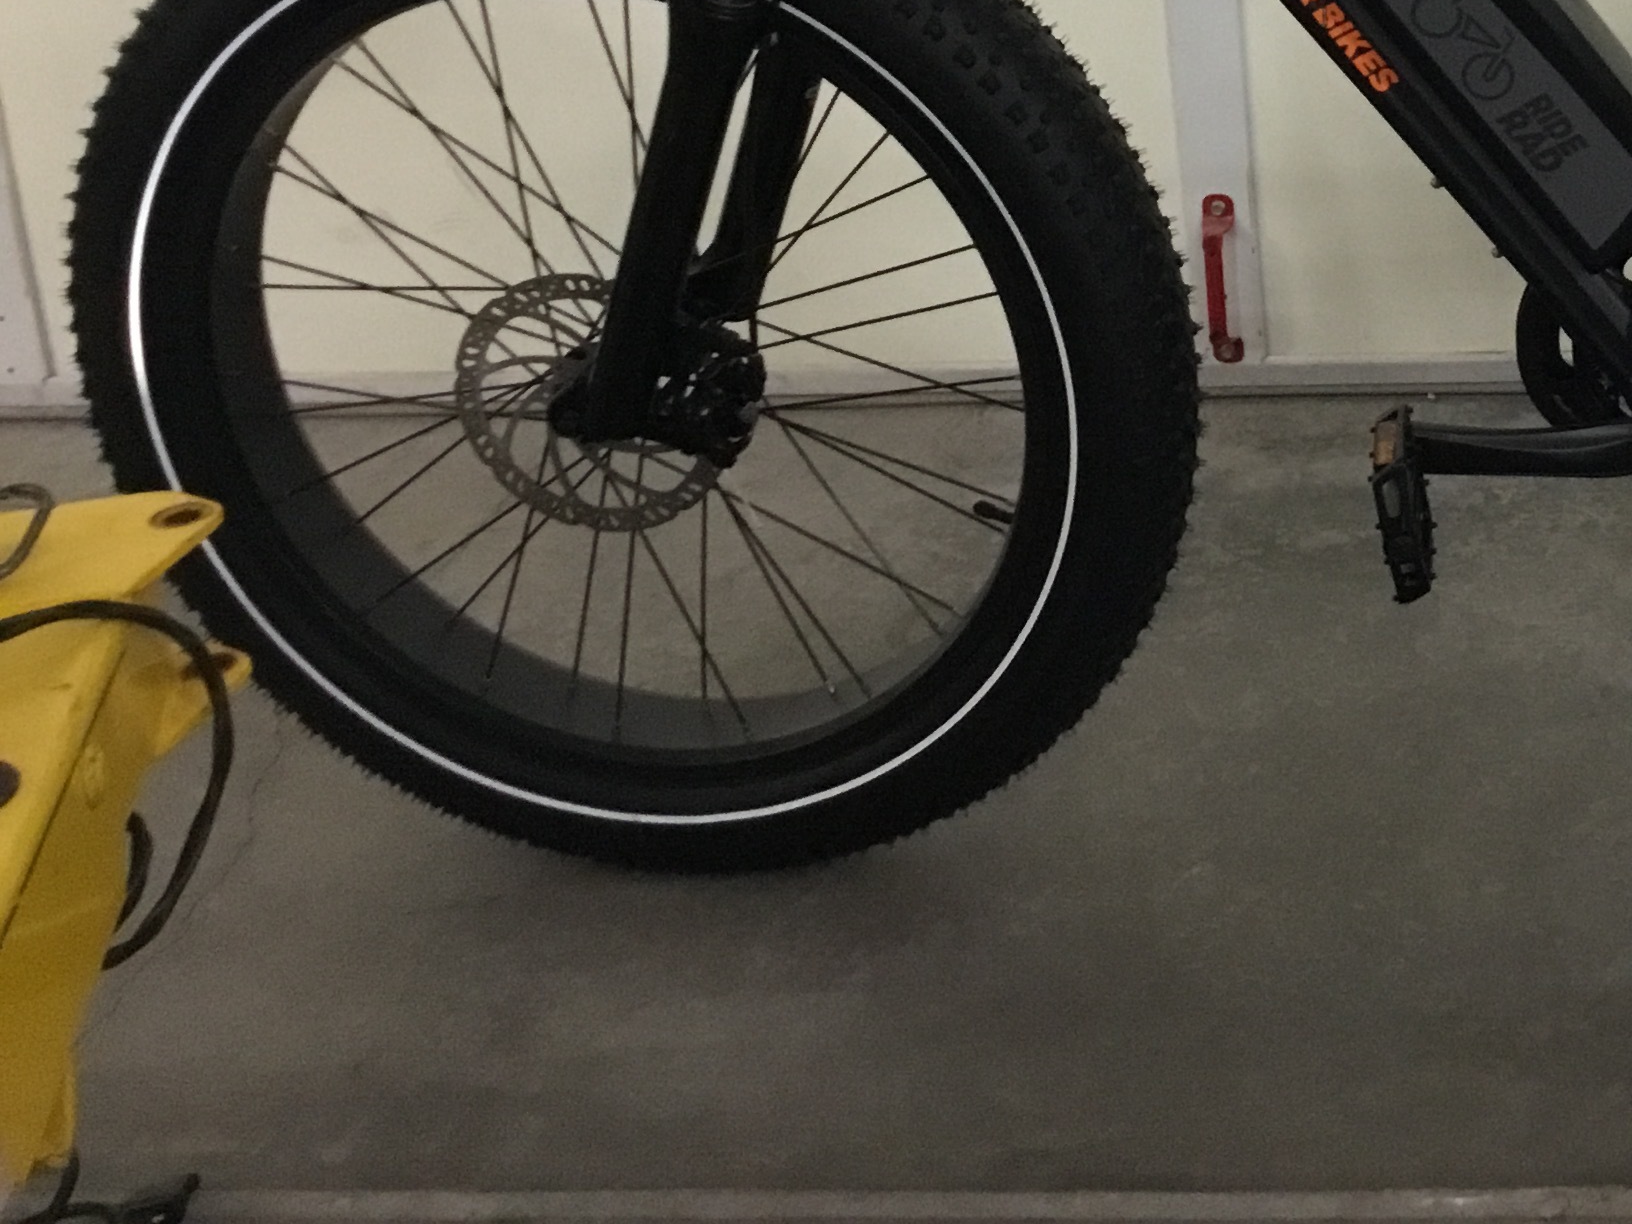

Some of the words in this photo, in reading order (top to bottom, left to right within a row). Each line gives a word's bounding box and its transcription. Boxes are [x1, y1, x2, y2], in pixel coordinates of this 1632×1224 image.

[1312, 2, 1398, 93] BIKES
[1495, 109, 1564, 172] RAD
[1522, 93, 1590, 157] RIDE
